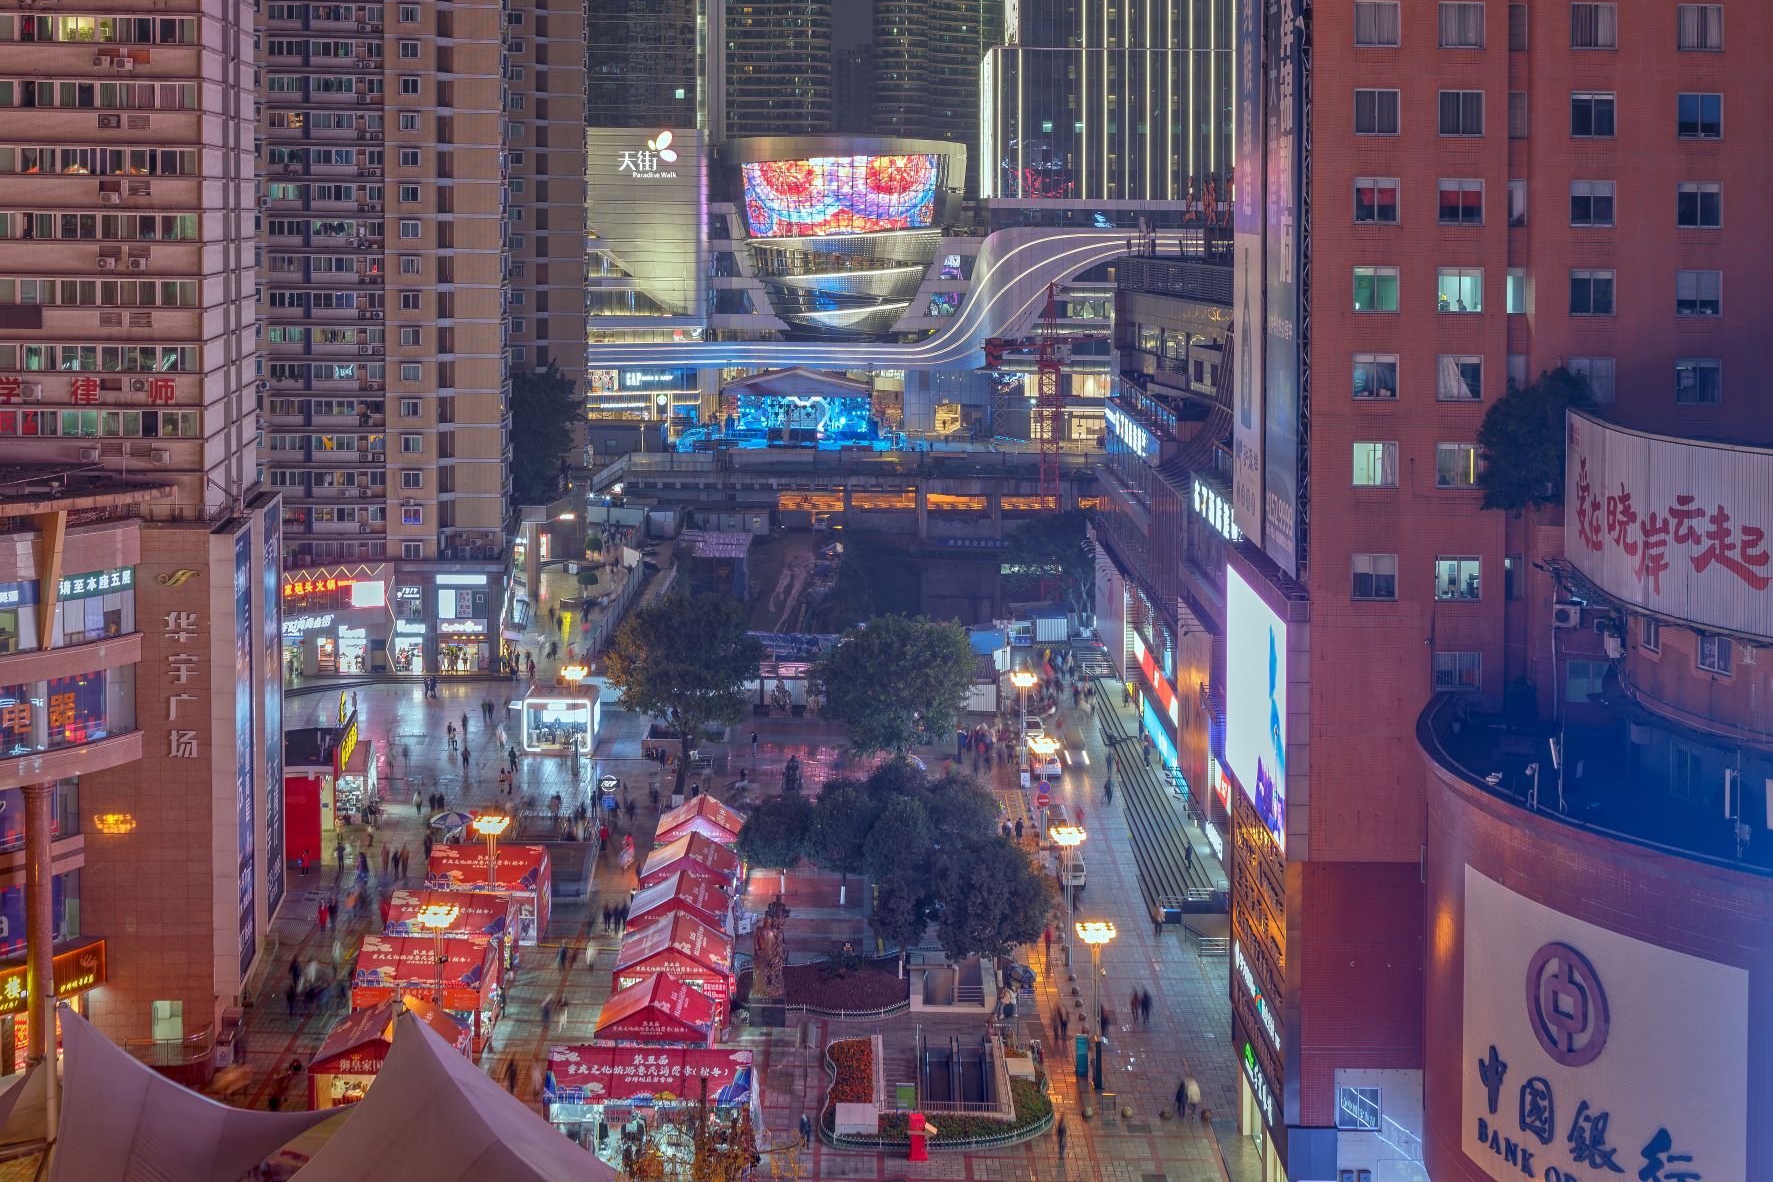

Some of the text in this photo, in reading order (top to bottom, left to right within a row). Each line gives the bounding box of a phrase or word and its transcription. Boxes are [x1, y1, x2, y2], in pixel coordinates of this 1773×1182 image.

[617, 150, 658, 171] 天街
[59, 570, 131, 595] 请至本座五层
[165, 611, 198, 759] 华宇广场
[2, 692, 76, 735] 电器
[633, 1054, 669, 1065] 第五届
[1477, 1117, 1535, 1178] BANK
